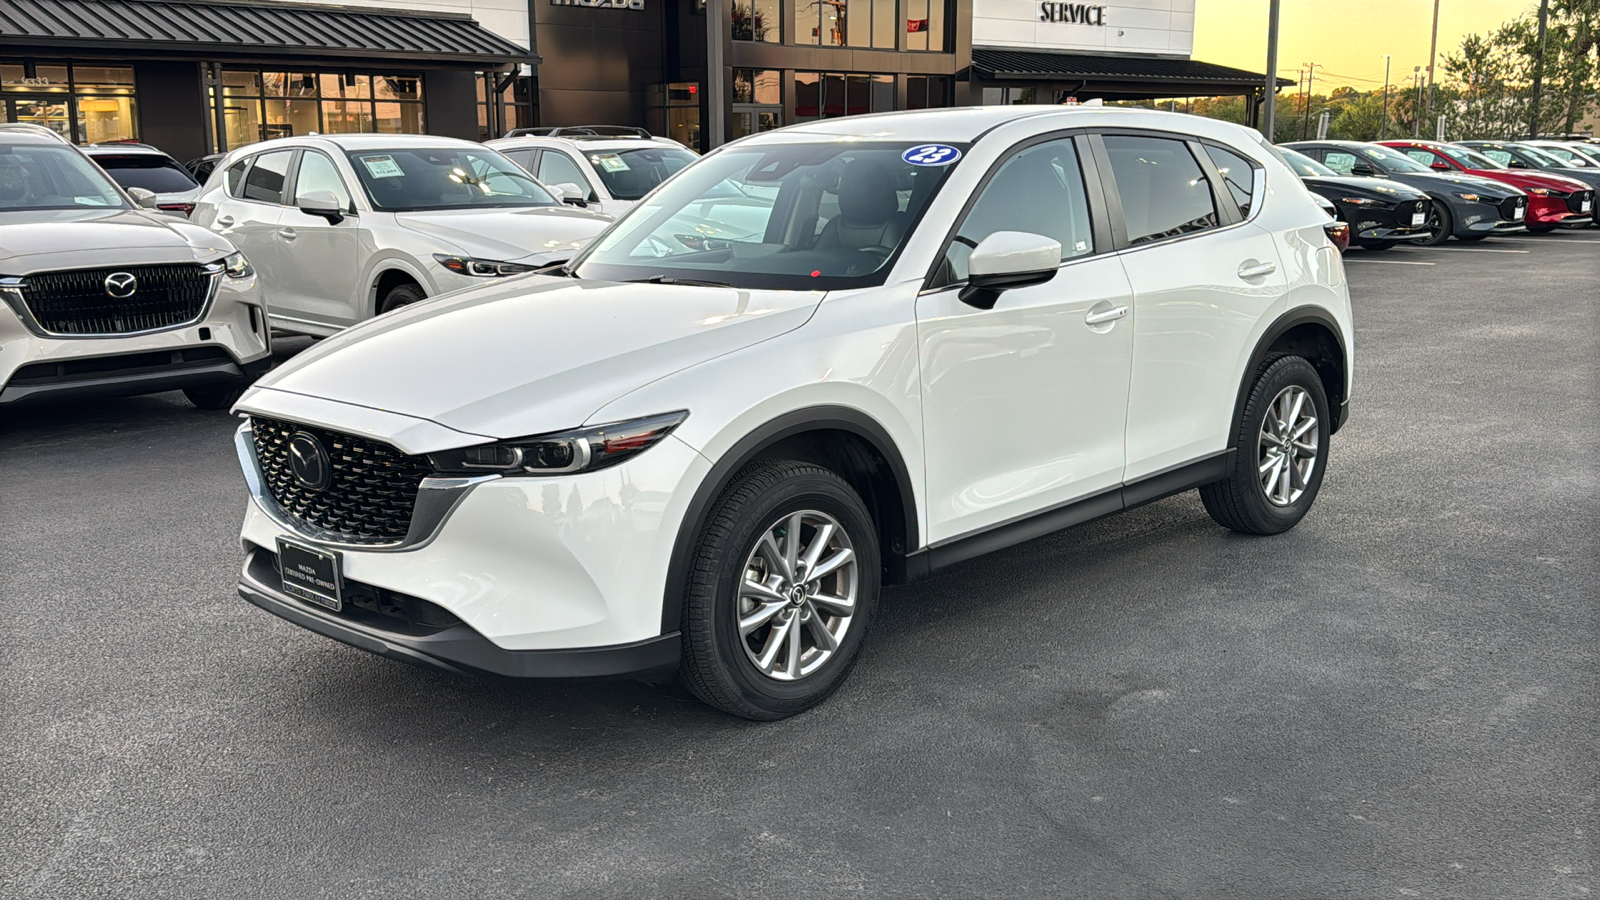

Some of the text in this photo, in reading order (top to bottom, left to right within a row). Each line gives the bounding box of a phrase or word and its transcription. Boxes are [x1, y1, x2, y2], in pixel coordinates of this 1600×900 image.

[1040, 1, 1107, 26] SERVICE
[908, 146, 952, 163] 23
[285, 566, 335, 590] CERTIFIED PRE-OWNED
[298, 563, 316, 575] MAZDA
